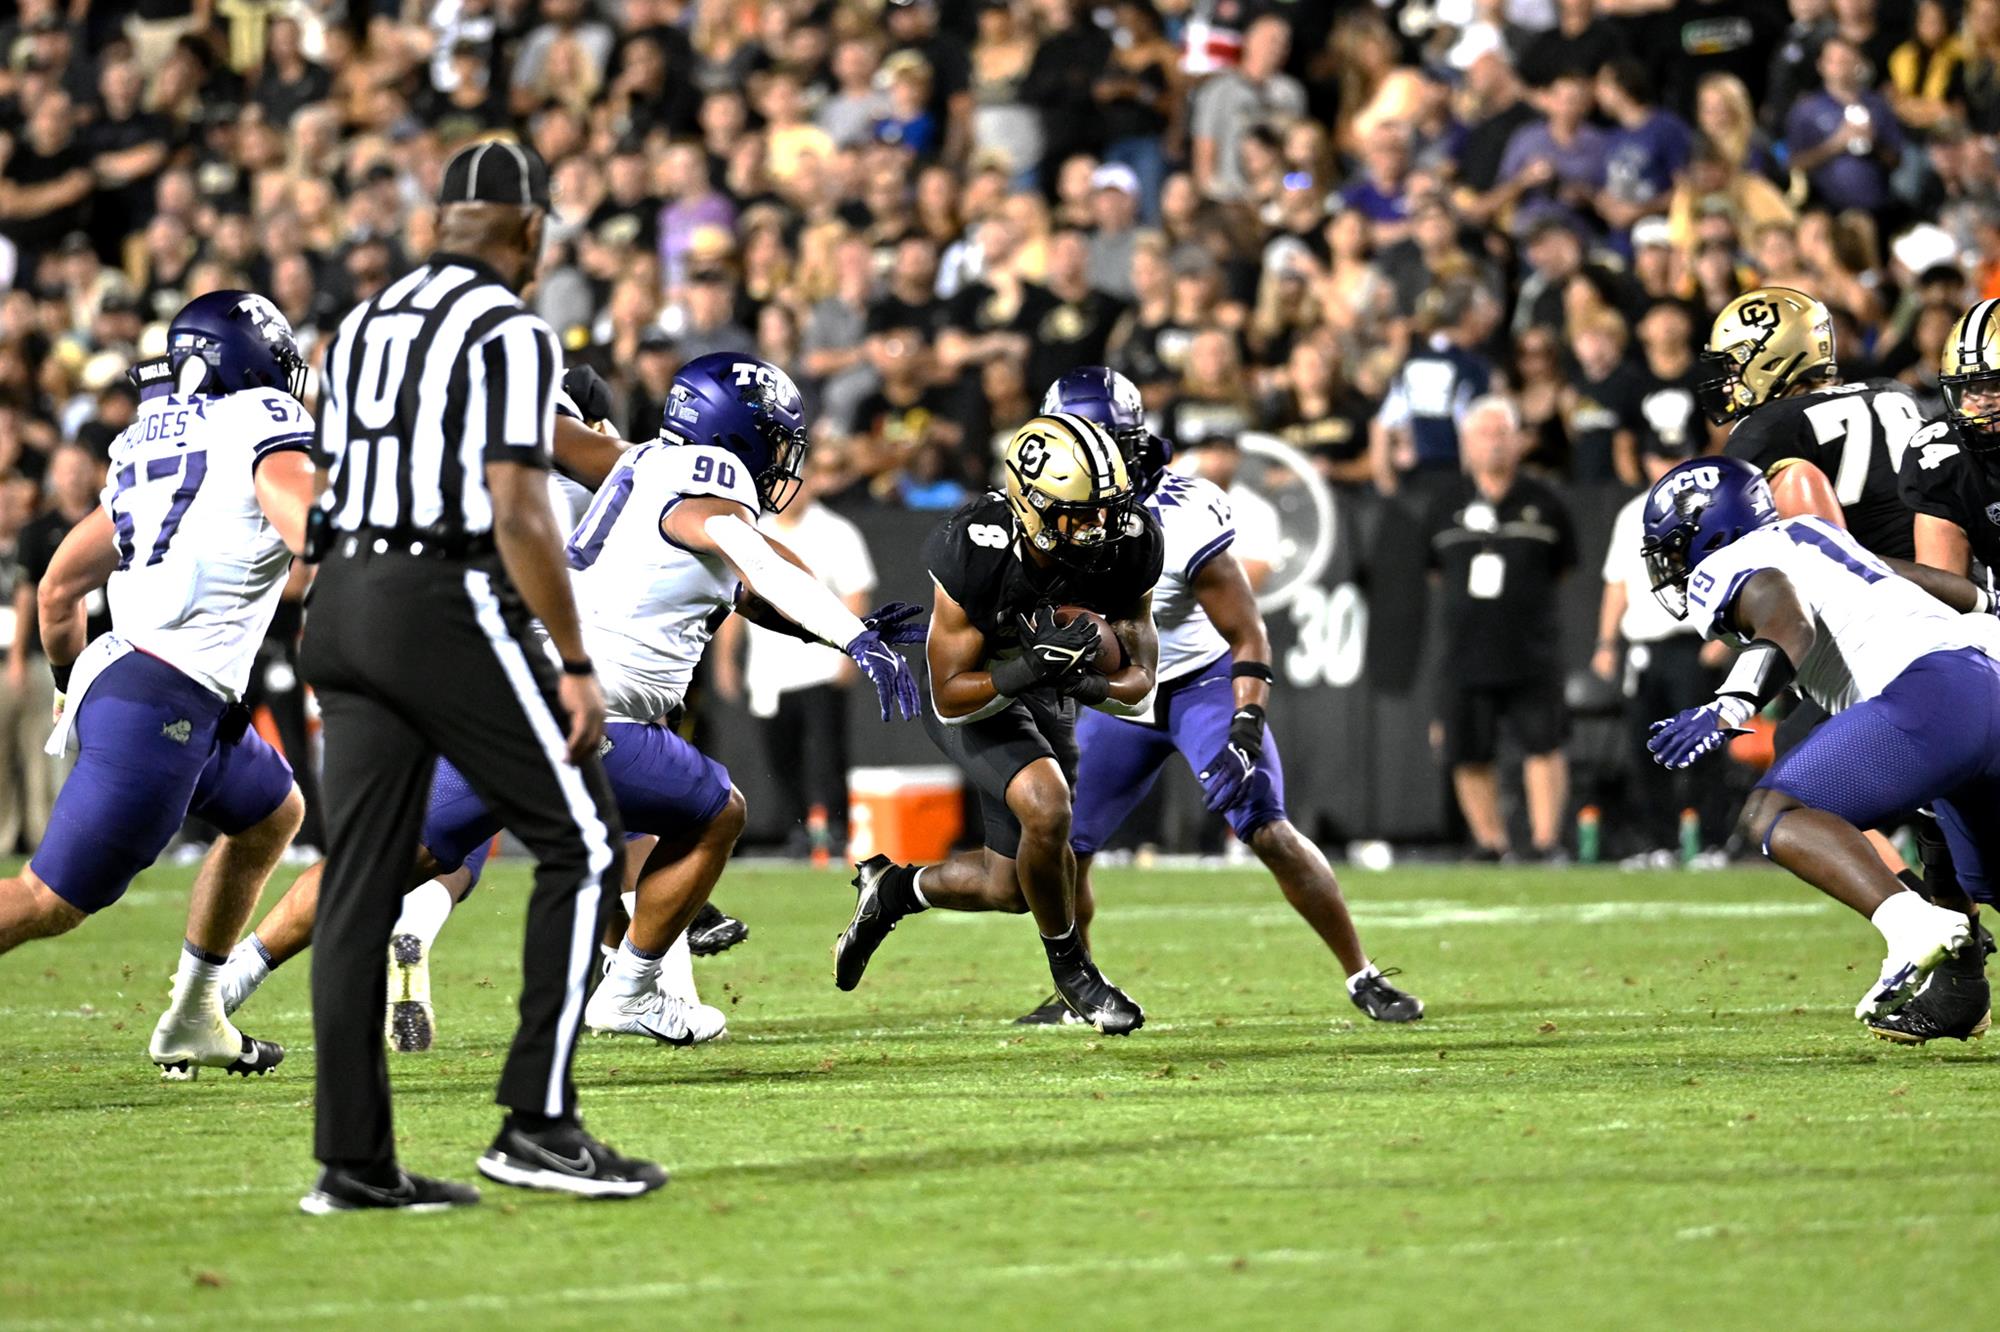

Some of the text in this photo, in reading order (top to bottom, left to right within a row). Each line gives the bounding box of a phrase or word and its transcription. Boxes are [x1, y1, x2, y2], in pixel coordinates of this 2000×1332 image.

[1908, 421, 1961, 471] 64
[691, 455, 736, 490] 90
[1653, 465, 1720, 514] TCU
[967, 523, 1010, 550] 8
[1689, 570, 1715, 608] 19
[1285, 583, 1368, 687] 30
